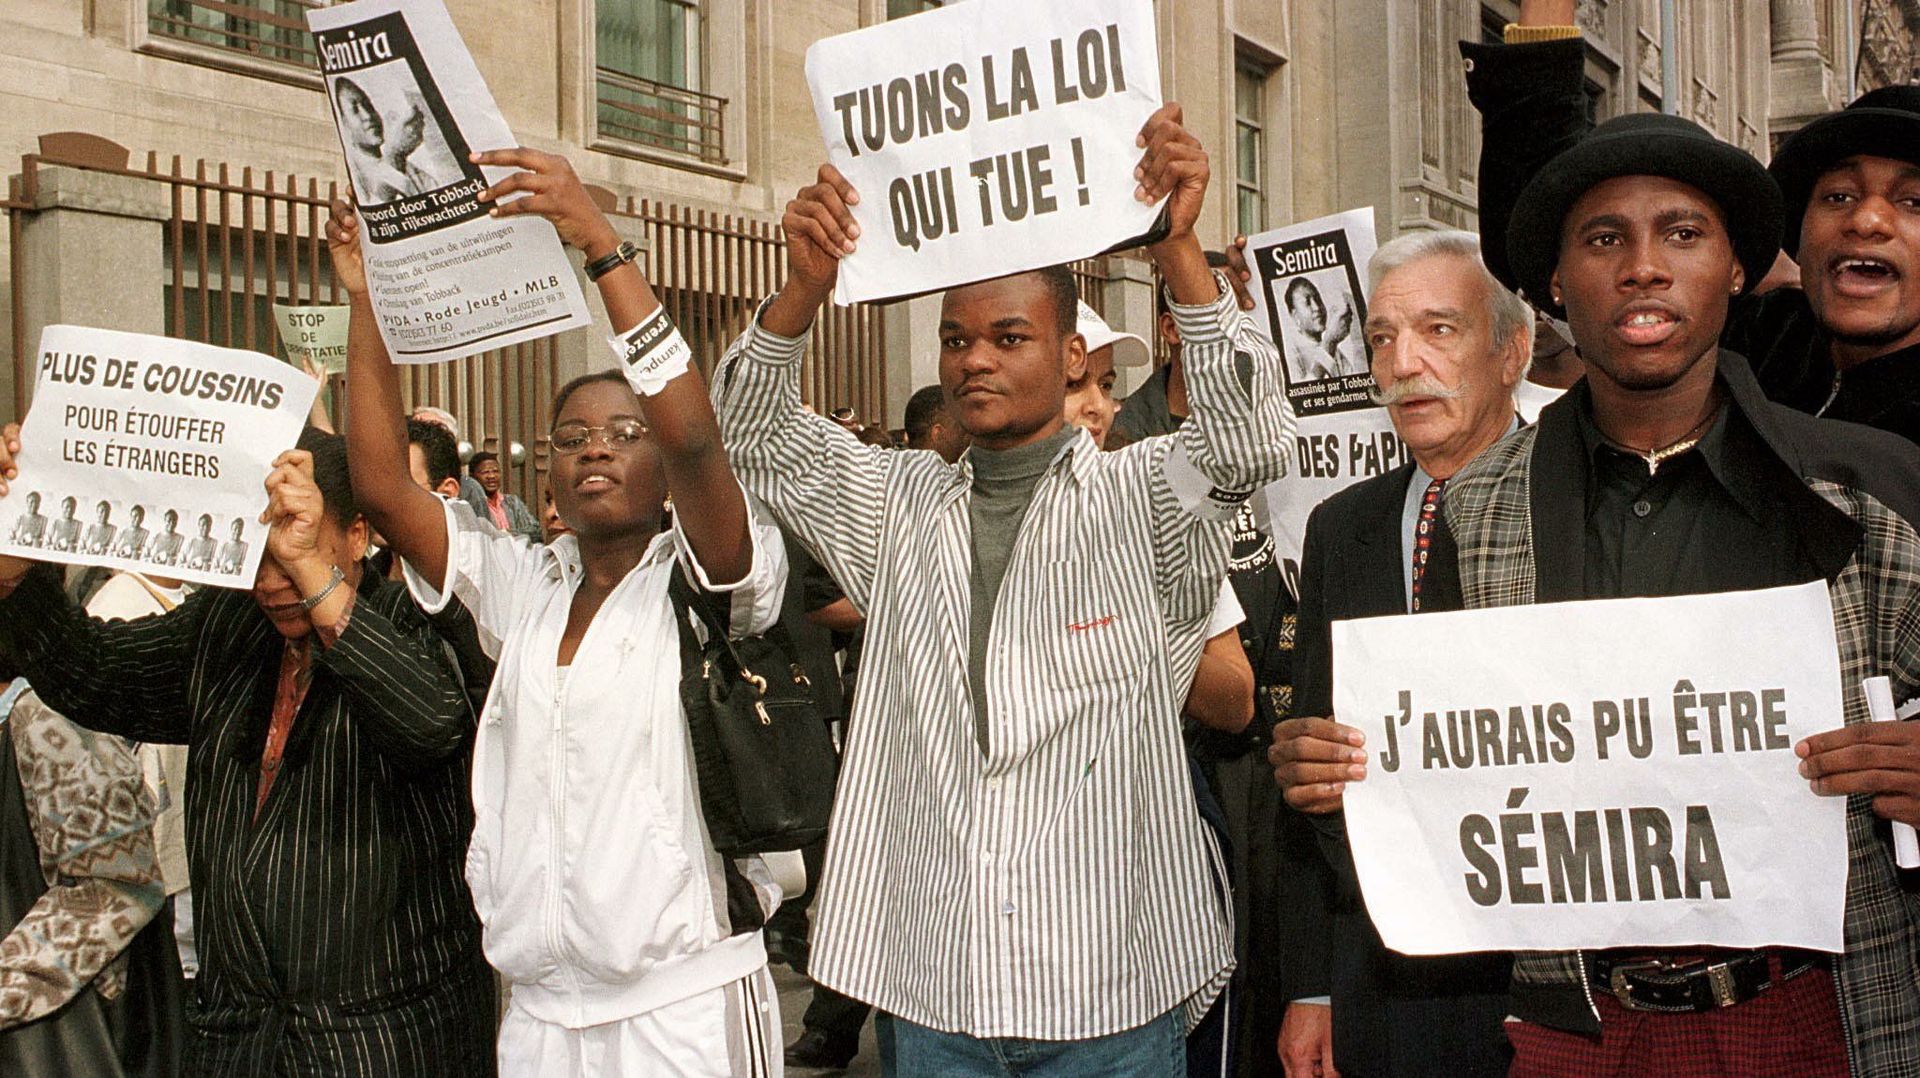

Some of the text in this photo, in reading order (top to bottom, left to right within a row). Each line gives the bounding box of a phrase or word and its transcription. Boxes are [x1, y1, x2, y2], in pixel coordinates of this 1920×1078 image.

[318, 30, 393, 71] Semira
[833, 23, 1127, 158] TUONS LA LOI
[361, 178, 486, 222] oord door Tobback
[889, 136, 1090, 252] QUI TUE !
[379, 222, 400, 237] zijn
[401, 200, 479, 231] rijkswachters
[447, 242, 458, 252] de
[1271, 240, 1338, 276] Semira
[424, 284, 462, 303] Tobback
[424, 306, 461, 323] Rode
[467, 290, 508, 315] Jeugd
[525, 275, 559, 294] MLB
[288, 313, 325, 327] STOP
[301, 332, 317, 343] DE
[286, 343, 347, 358] RTATIE
[40, 352, 284, 410] PLUS DE COUSSINS
[1289, 375, 1377, 397] assassinée par Tobback
[1303, 391, 1368, 408] et ses gendarmes
[64, 405, 226, 444] POUR ÉTOUFFER
[63, 439, 220, 479] LES ÉTRANGERS
[1296, 433, 1340, 479] DES
[1380, 679, 1791, 773] J'AURAIS PU ÊTRE
[1459, 787, 1732, 907] SÉMIRA
